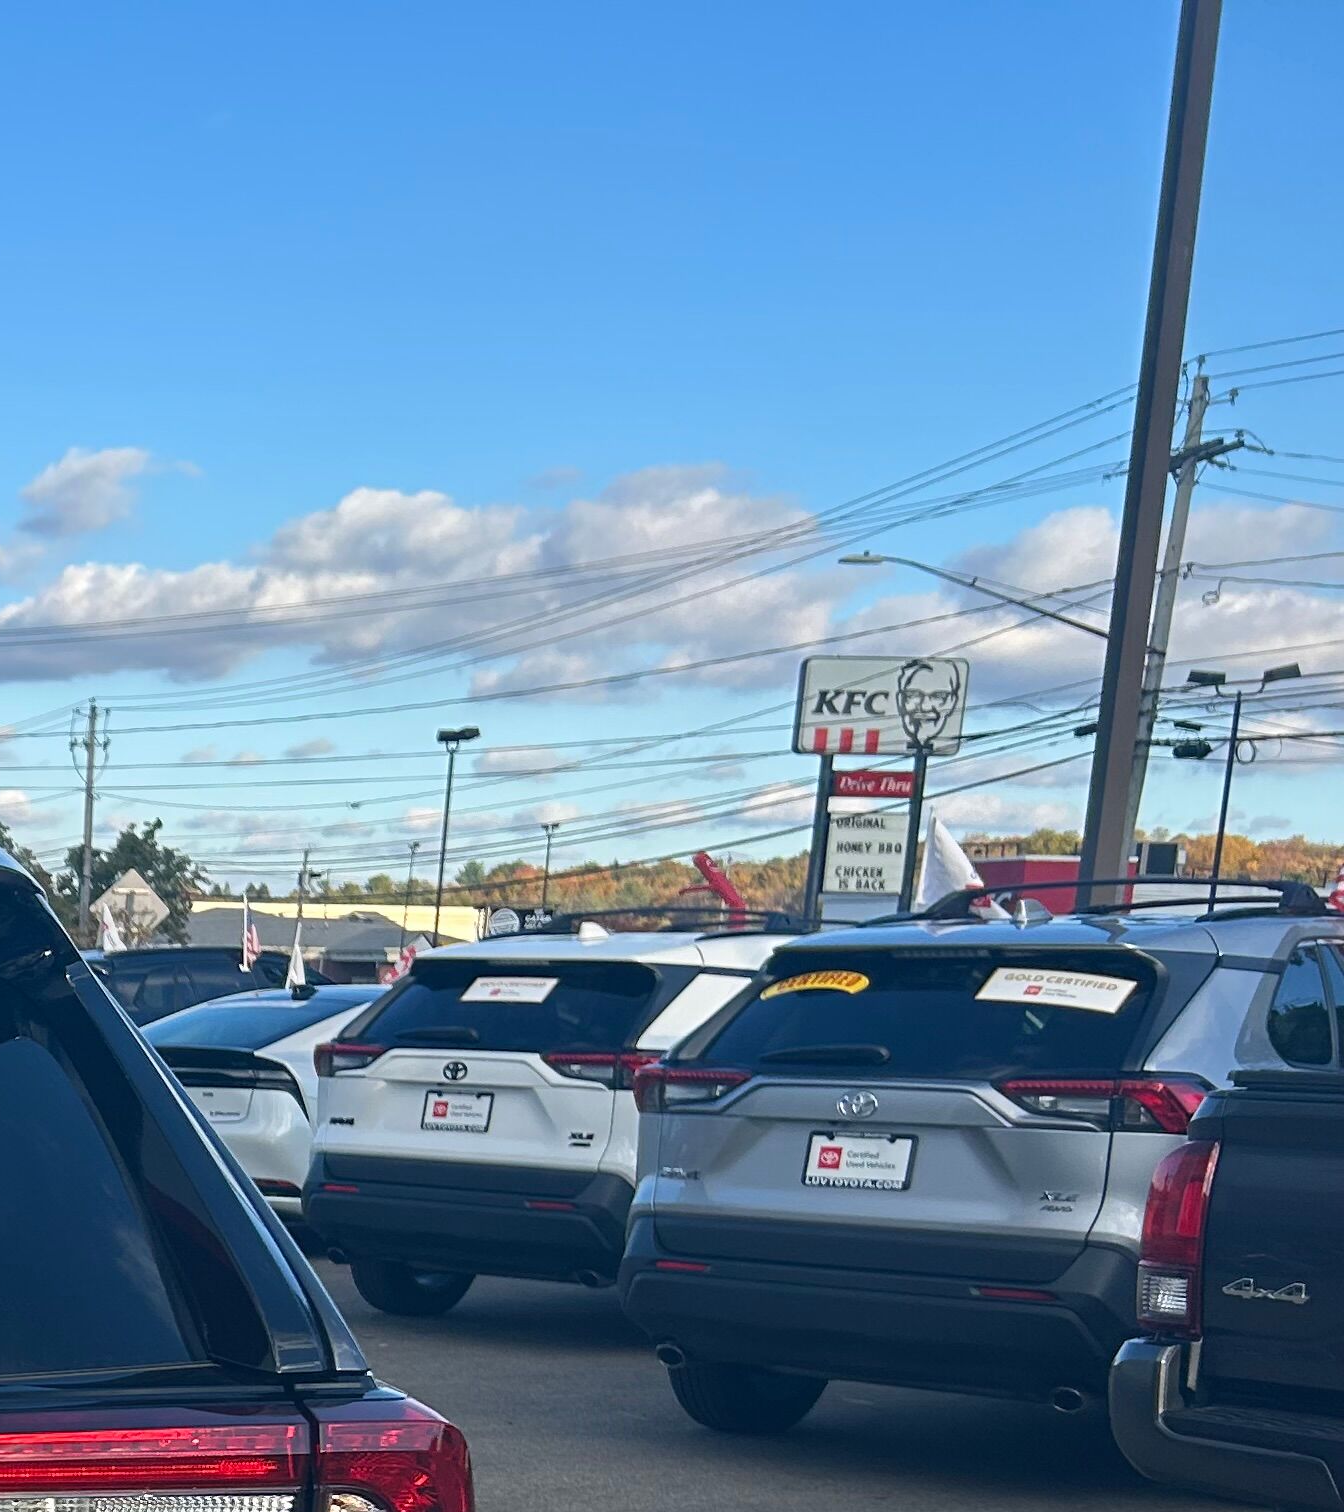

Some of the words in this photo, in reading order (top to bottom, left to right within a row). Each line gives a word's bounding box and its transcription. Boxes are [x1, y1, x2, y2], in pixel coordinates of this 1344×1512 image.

[813, 689, 890, 715] KFC
[839, 776, 874, 793] Drive
[880, 777, 912, 793] Thru
[836, 816, 886, 829] ORIGINAL
[836, 842, 871, 853] HONEY
[878, 842, 902, 854] BBQ
[835, 866, 883, 878] CHICKEN
[838, 879, 849, 889] IS
[856, 879, 885, 891] BACK
[1004, 972, 1045, 982] GOLD
[1046, 975, 1119, 991] CERTIFIED
